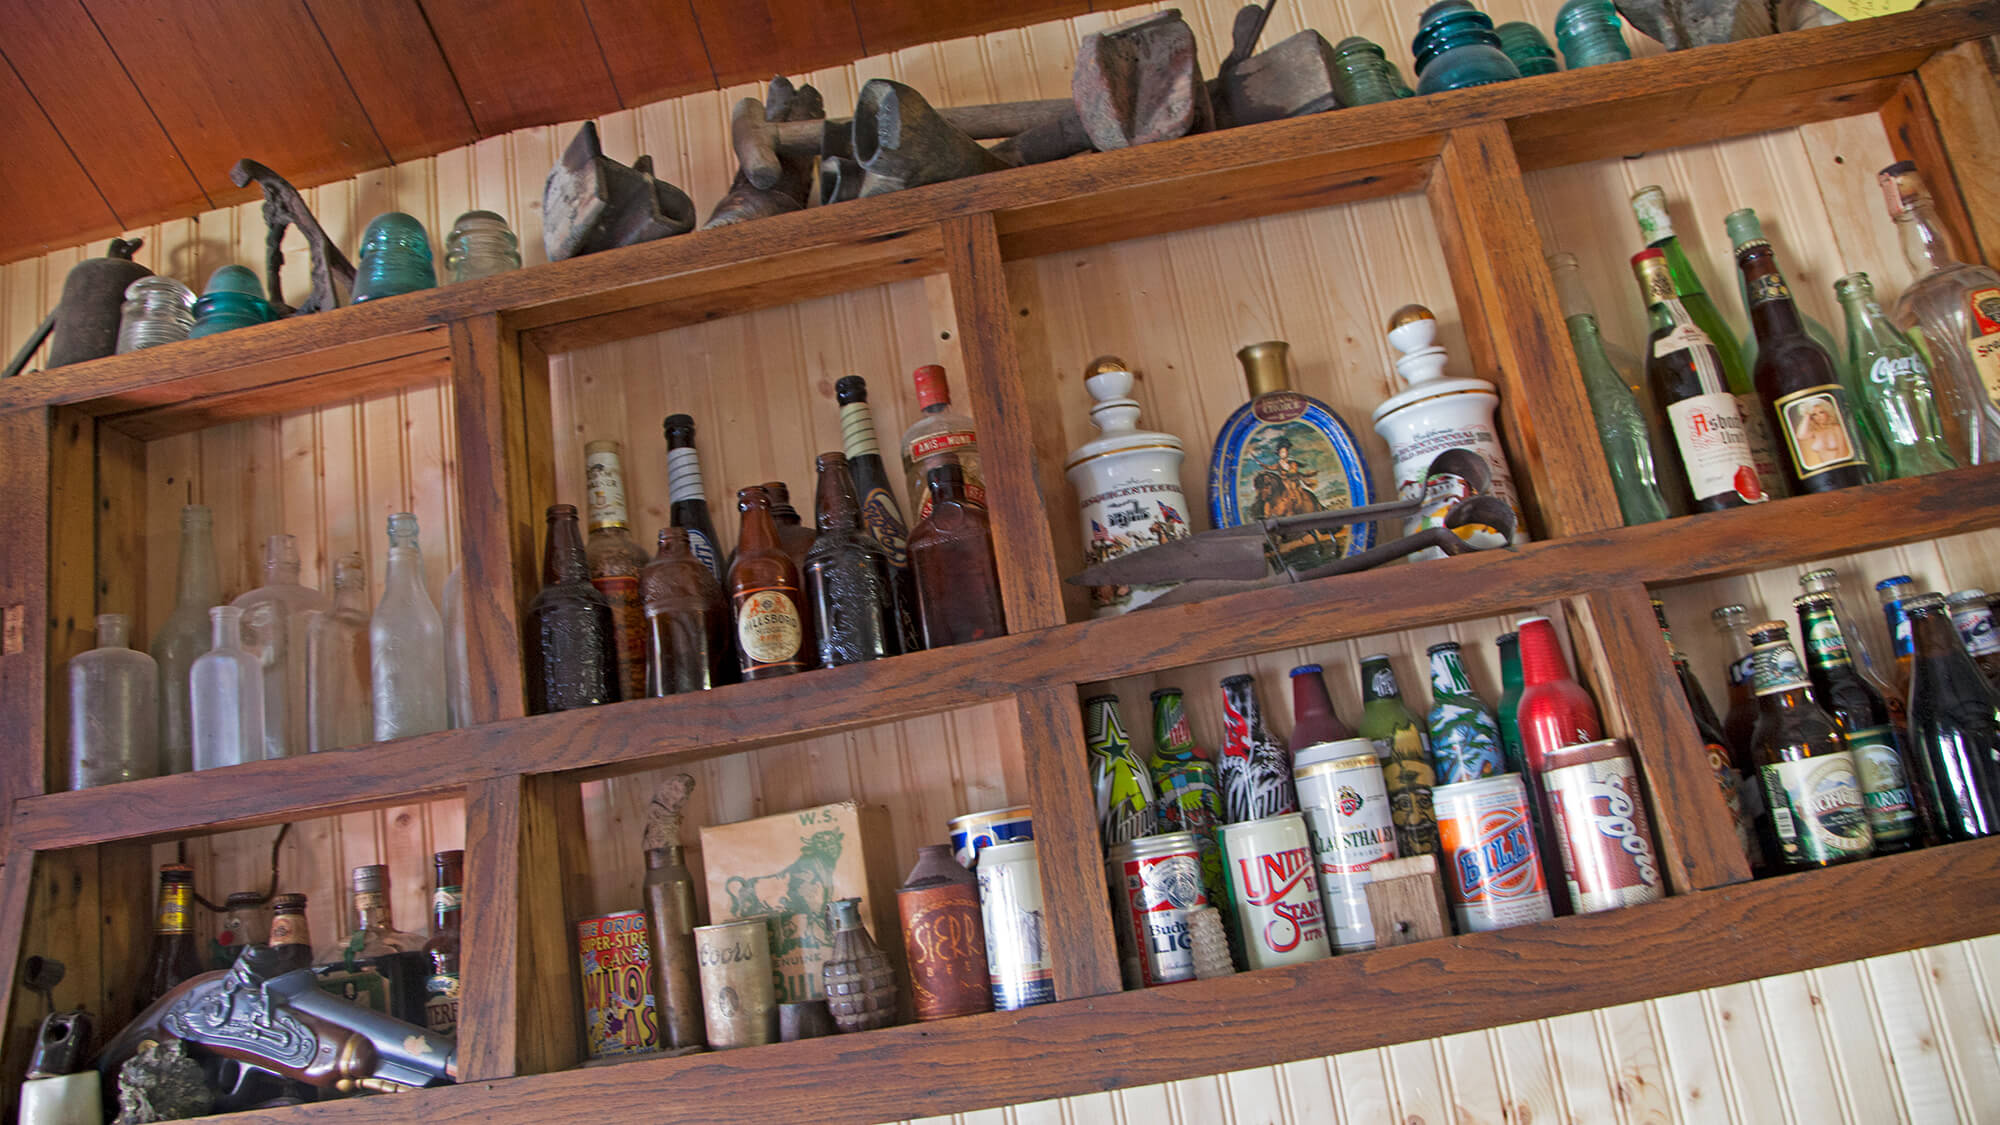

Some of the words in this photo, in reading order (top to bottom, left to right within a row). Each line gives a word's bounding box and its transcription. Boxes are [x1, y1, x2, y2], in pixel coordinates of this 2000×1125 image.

[1587, 773, 1658, 886] Coors
[603, 916, 645, 934] ORIG
[915, 911, 982, 964] SIERR
[700, 942, 753, 967] Coors
